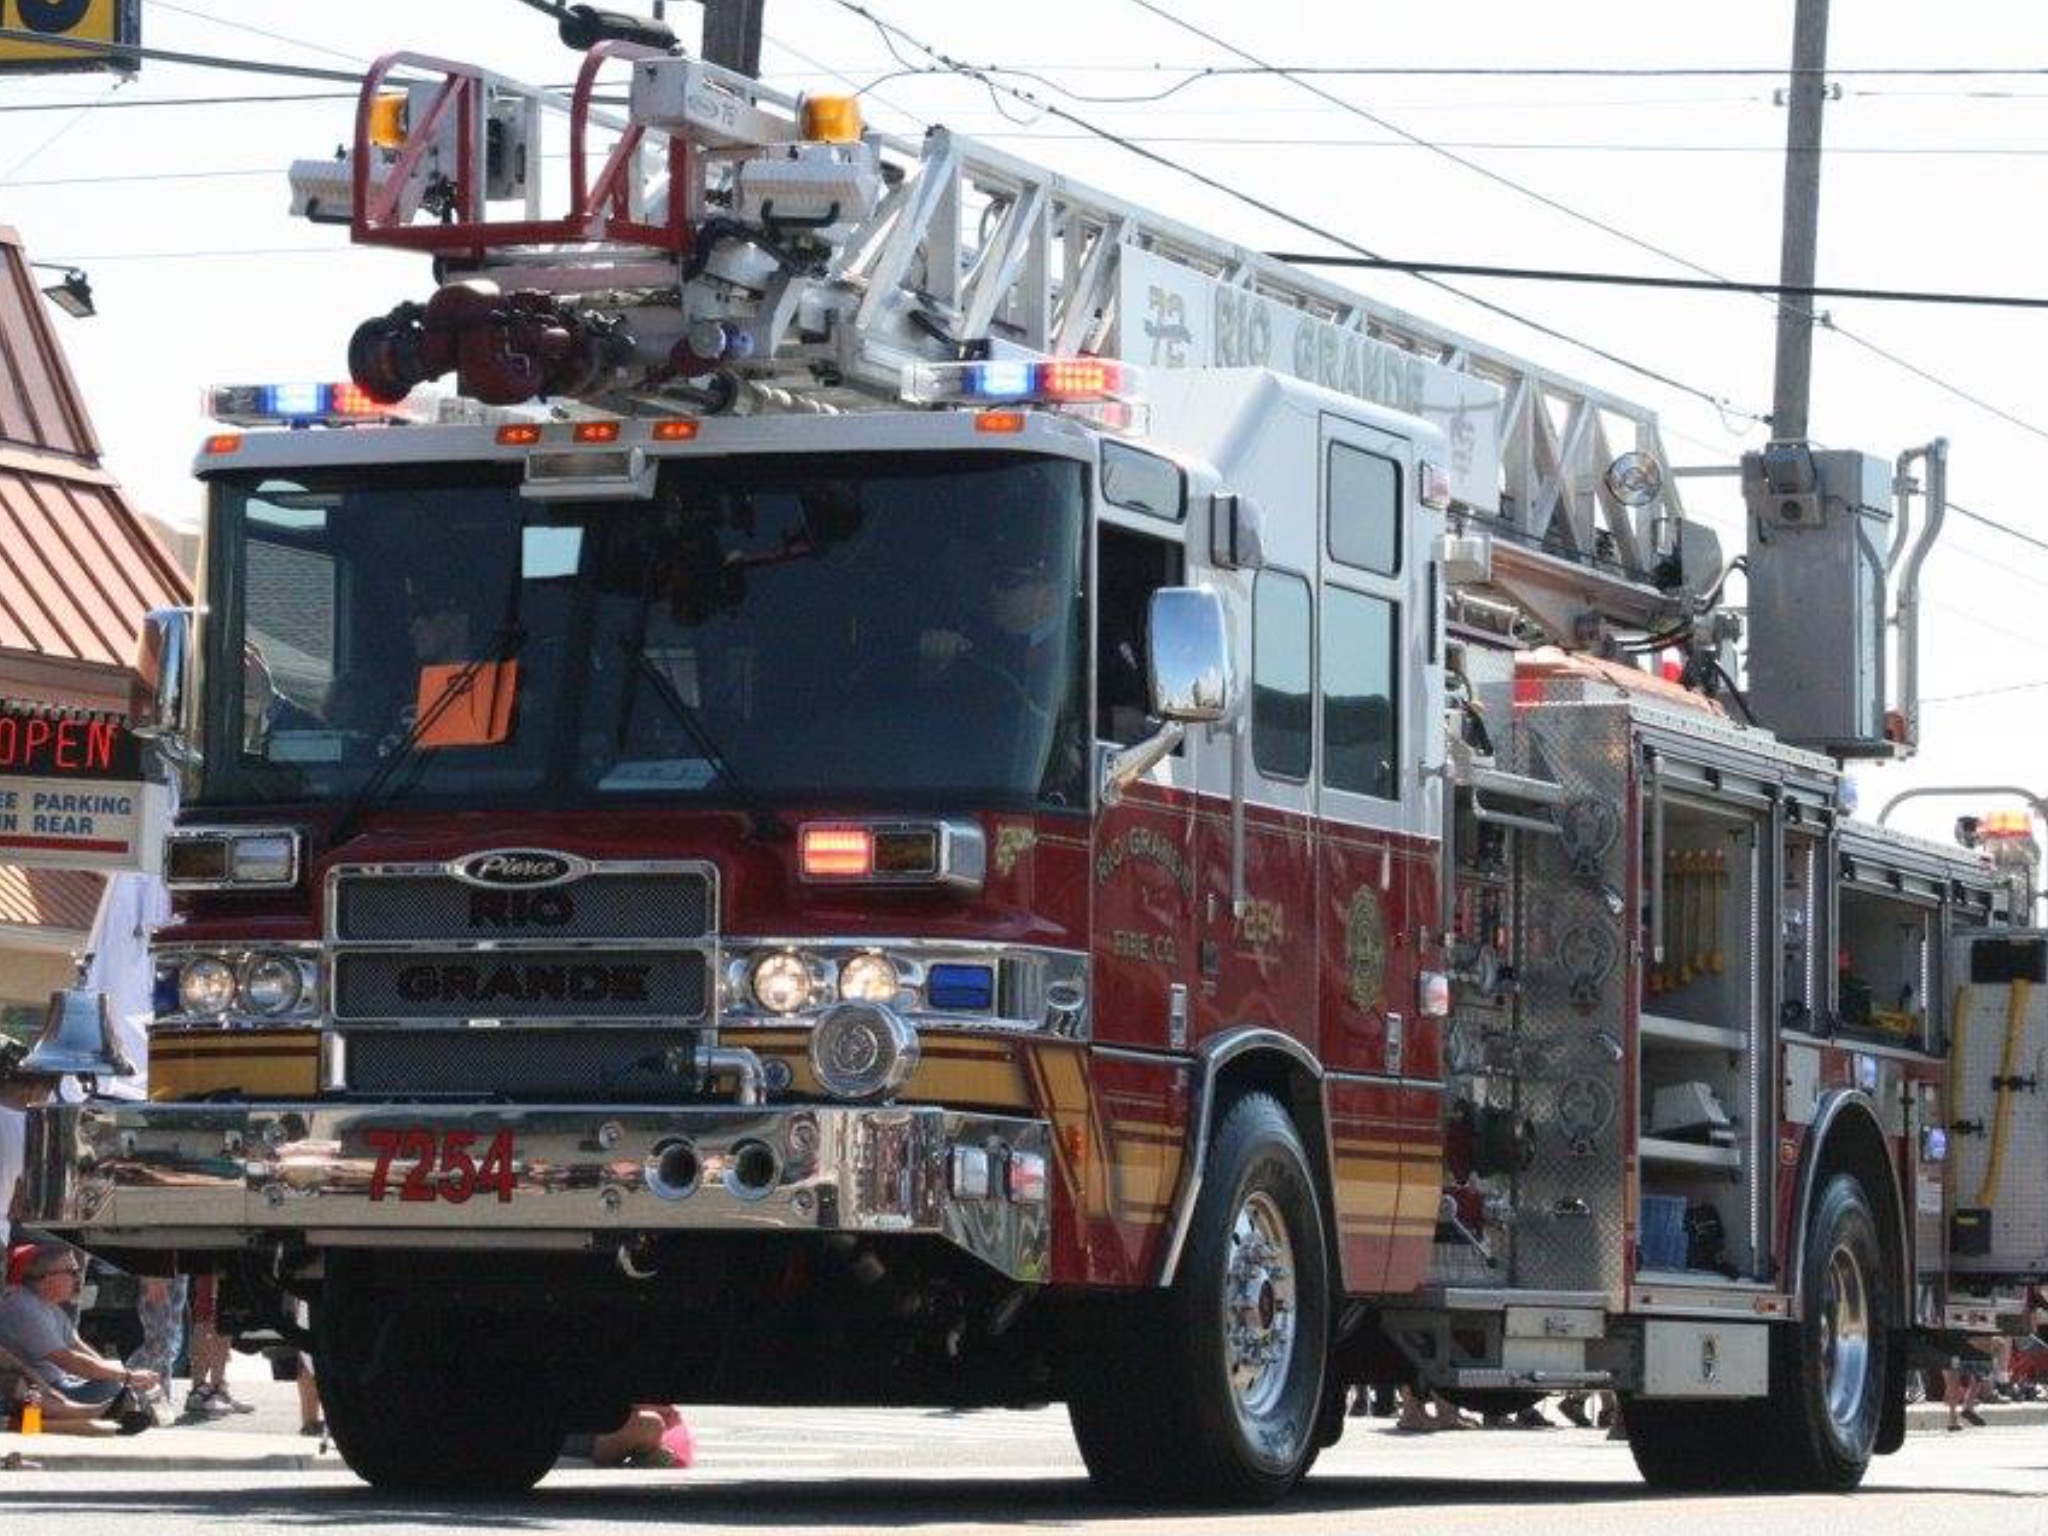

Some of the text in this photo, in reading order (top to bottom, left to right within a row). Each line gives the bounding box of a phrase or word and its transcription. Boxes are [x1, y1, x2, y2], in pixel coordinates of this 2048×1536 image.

[1215, 284, 1272, 369] RIO
[1296, 313, 1426, 417] GRANDE
[0, 716, 118, 771] OPEN
[34, 792, 131, 815] PARKING
[34, 814, 93, 834] REAR
[477, 856, 557, 879] Pierce
[470, 886, 573, 926] RIO
[1113, 929, 1149, 961] FIRE
[399, 964, 651, 1001] GRANDE
[369, 1127, 518, 1204] 7254
